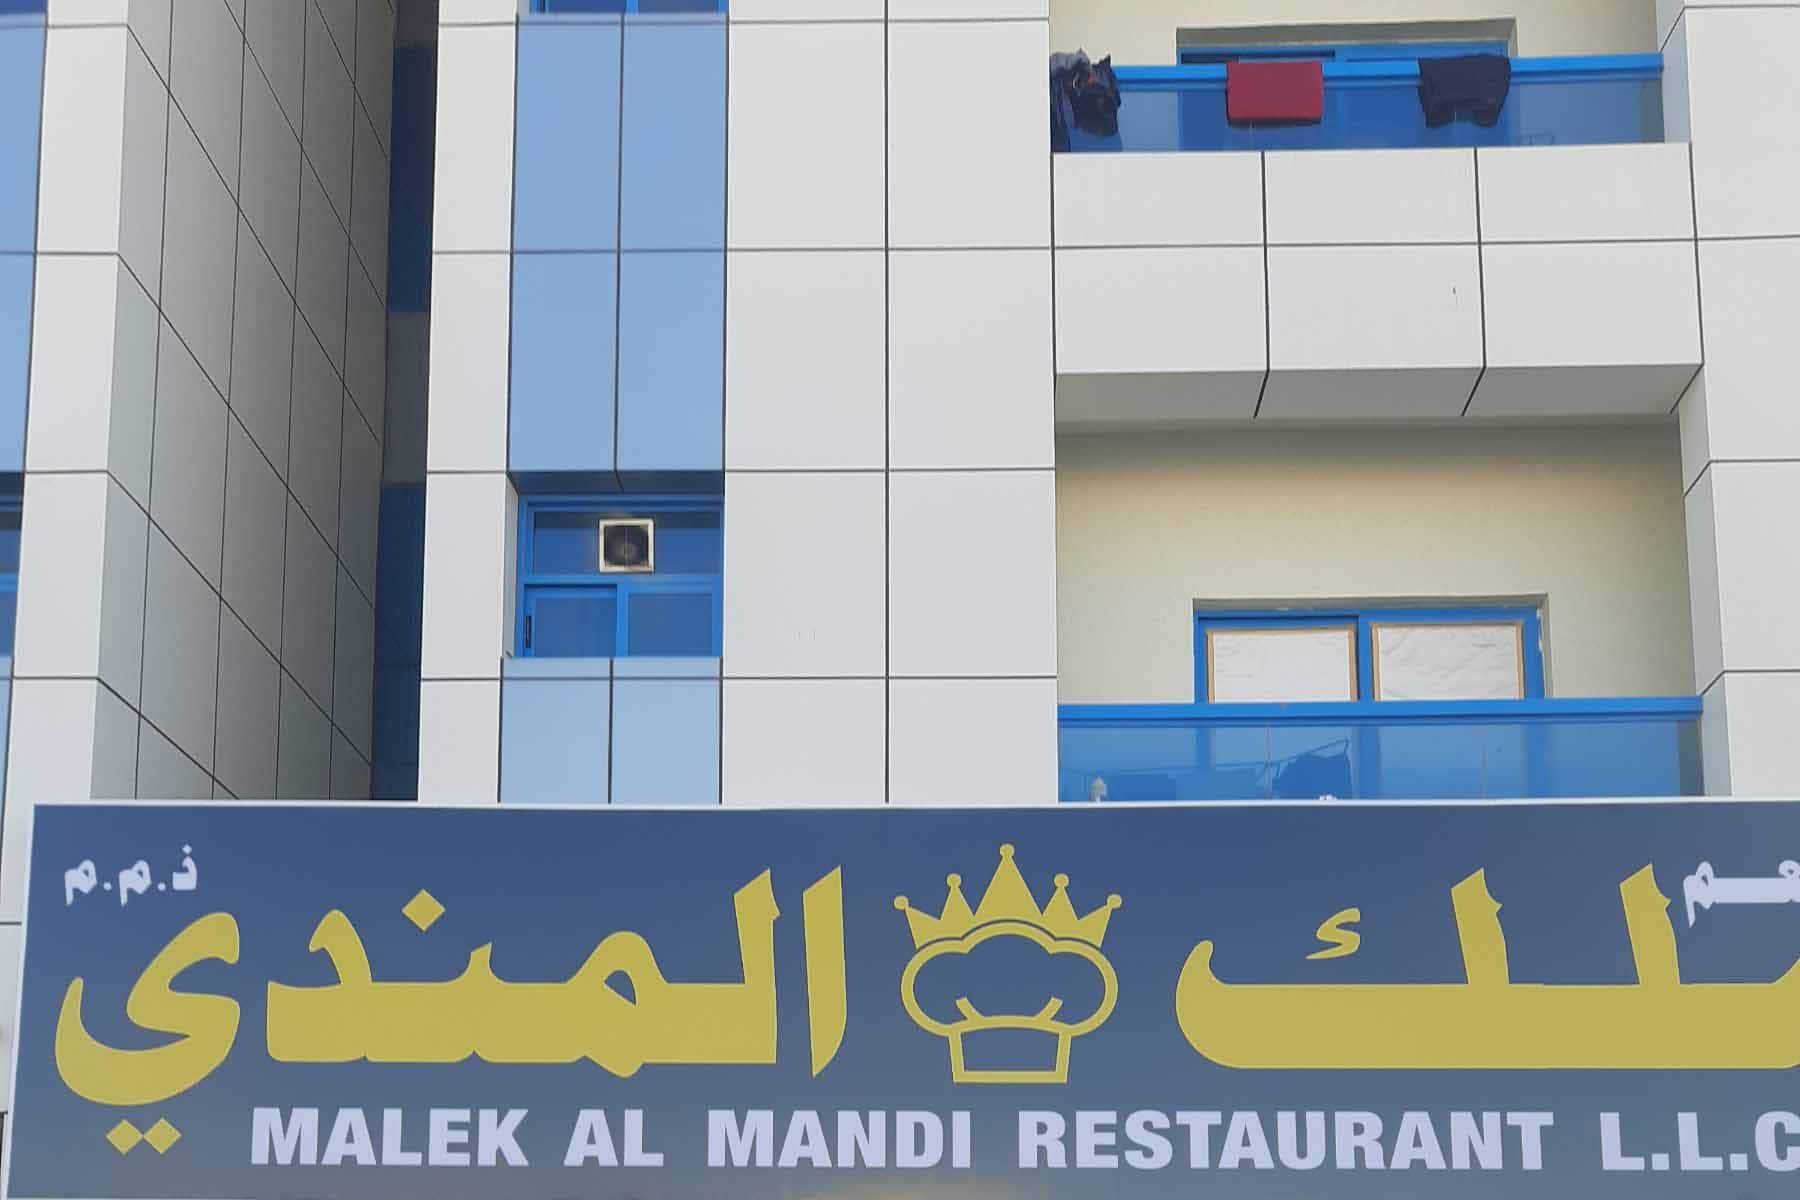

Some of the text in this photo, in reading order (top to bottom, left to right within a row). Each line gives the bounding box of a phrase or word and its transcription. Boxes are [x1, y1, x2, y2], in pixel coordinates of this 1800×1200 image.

[55, 864, 1800, 1154] لك المندي
[251, 1107, 529, 1166] MALEK
[564, 1109, 664, 1167] AL
[707, 1110, 971, 1168] MANDI
[1018, 1111, 1554, 1170] RESTAURANT
